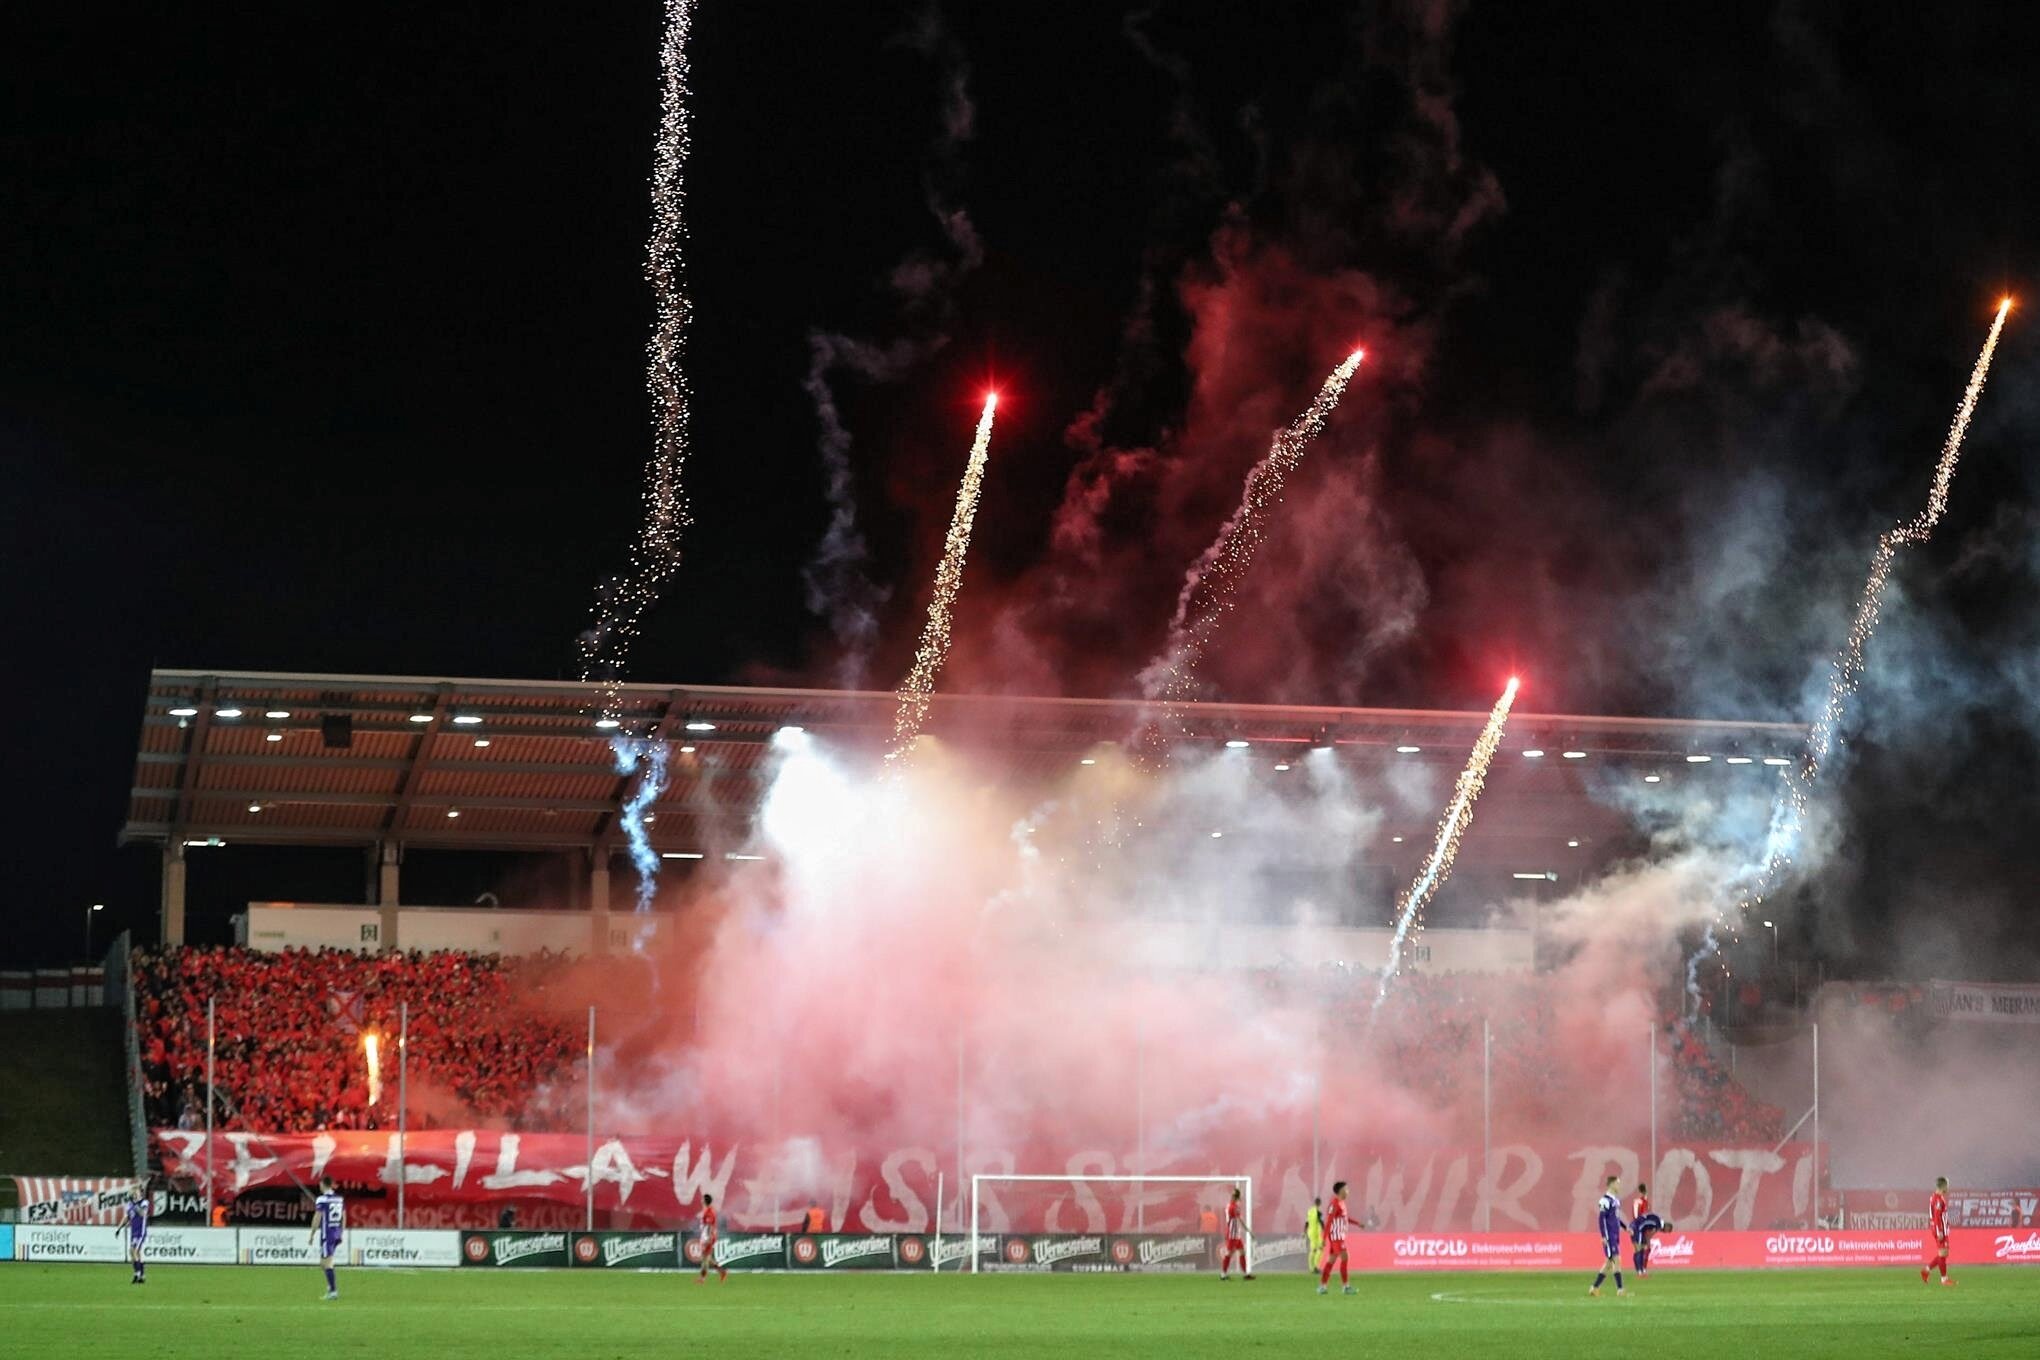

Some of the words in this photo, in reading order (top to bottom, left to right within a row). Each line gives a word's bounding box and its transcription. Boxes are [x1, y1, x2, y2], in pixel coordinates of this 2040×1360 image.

[1365, 1140, 1545, 1234] WIR
[28, 1201, 59, 1218] FSV
[31, 1243, 88, 1256] creativ.
[143, 1245, 200, 1258] creativ.
[255, 1246, 312, 1259] creativ.
[366, 1248, 422, 1261] creativ.
[494, 1232, 566, 1265] Wernesgrüner
[603, 1232, 675, 1266] Wernesgrüner
[821, 1234, 892, 1267] Wernesgrüner
[928, 1235, 998, 1267] Wernesrüner
[1032, 1236, 1102, 1266] Wernesgrüner
[1394, 1237, 1468, 1257] GÜTZOLD
[1472, 1242, 1531, 1254] Elektrotechnik
[1534, 1242, 1563, 1254] GmbH
[1766, 1233, 1835, 1255] GÜTZOLD
[1838, 1240, 1897, 1251] Elektrotechnik
[1901, 1239, 1923, 1250] GmbH
